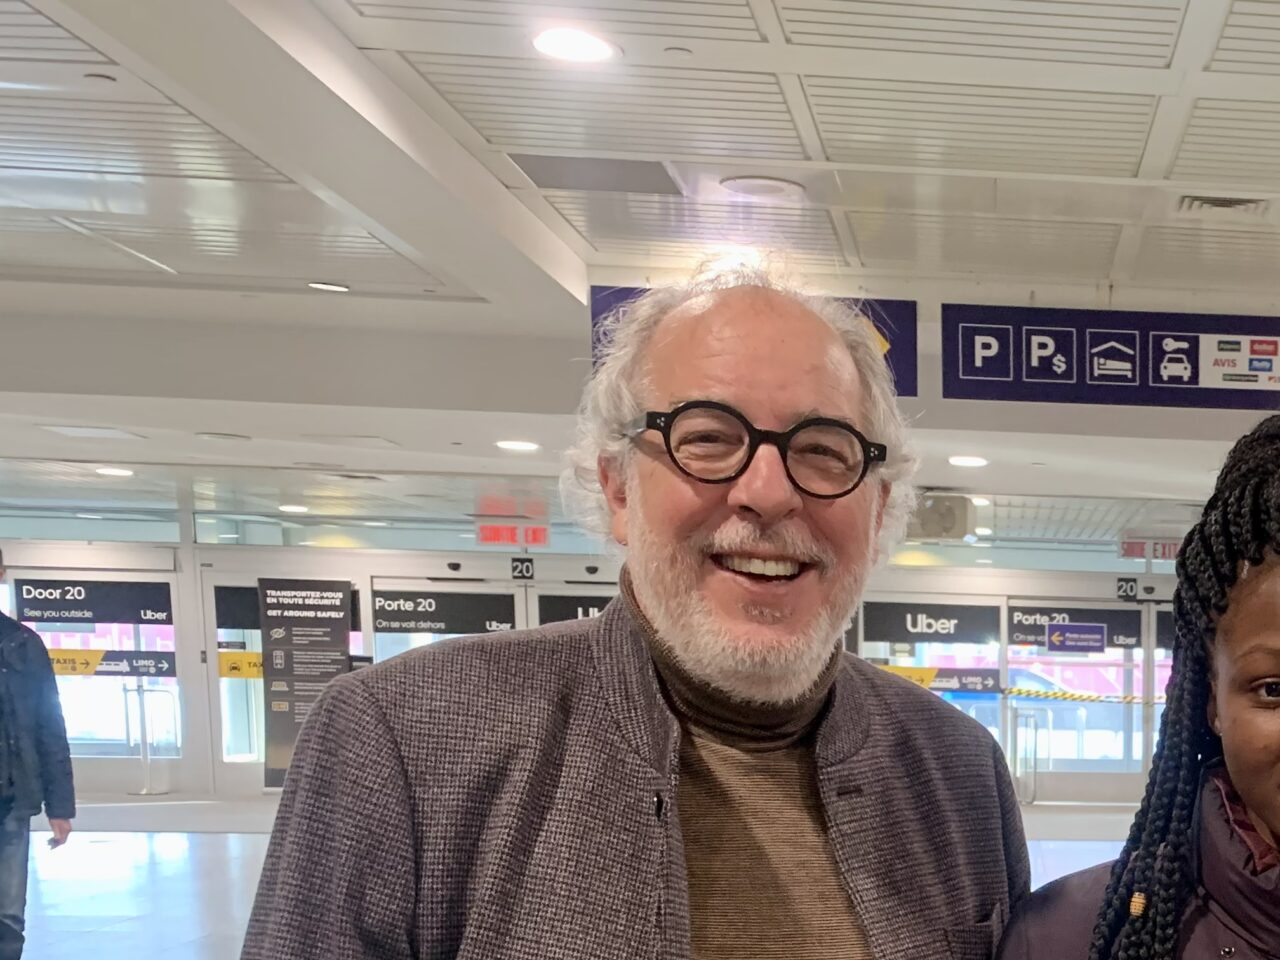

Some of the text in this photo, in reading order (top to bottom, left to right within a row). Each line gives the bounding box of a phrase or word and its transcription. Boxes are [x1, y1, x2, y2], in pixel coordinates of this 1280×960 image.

[974, 335, 999, 367] P
[1213, 358, 1237, 368] AVIS
[512, 562, 533, 577] 20
[22, 585, 85, 600] Door 20
[266, 590, 343, 598] TRANSPORTEZ-VOUS
[1117, 582, 1136, 596] 20
[375, 597, 436, 612] Porte 20
[23, 608, 93, 619] See you outside
[141, 609, 168, 620] Uber
[1013, 611, 1070, 625] Porte 20
[376, 619, 390, 628] On
[400, 620, 416, 628] voit
[416, 620, 446, 629] dehors
[485, 620, 512, 631] Uber
[905, 613, 958, 634] Uber
[1113, 635, 1137, 645] Uber
